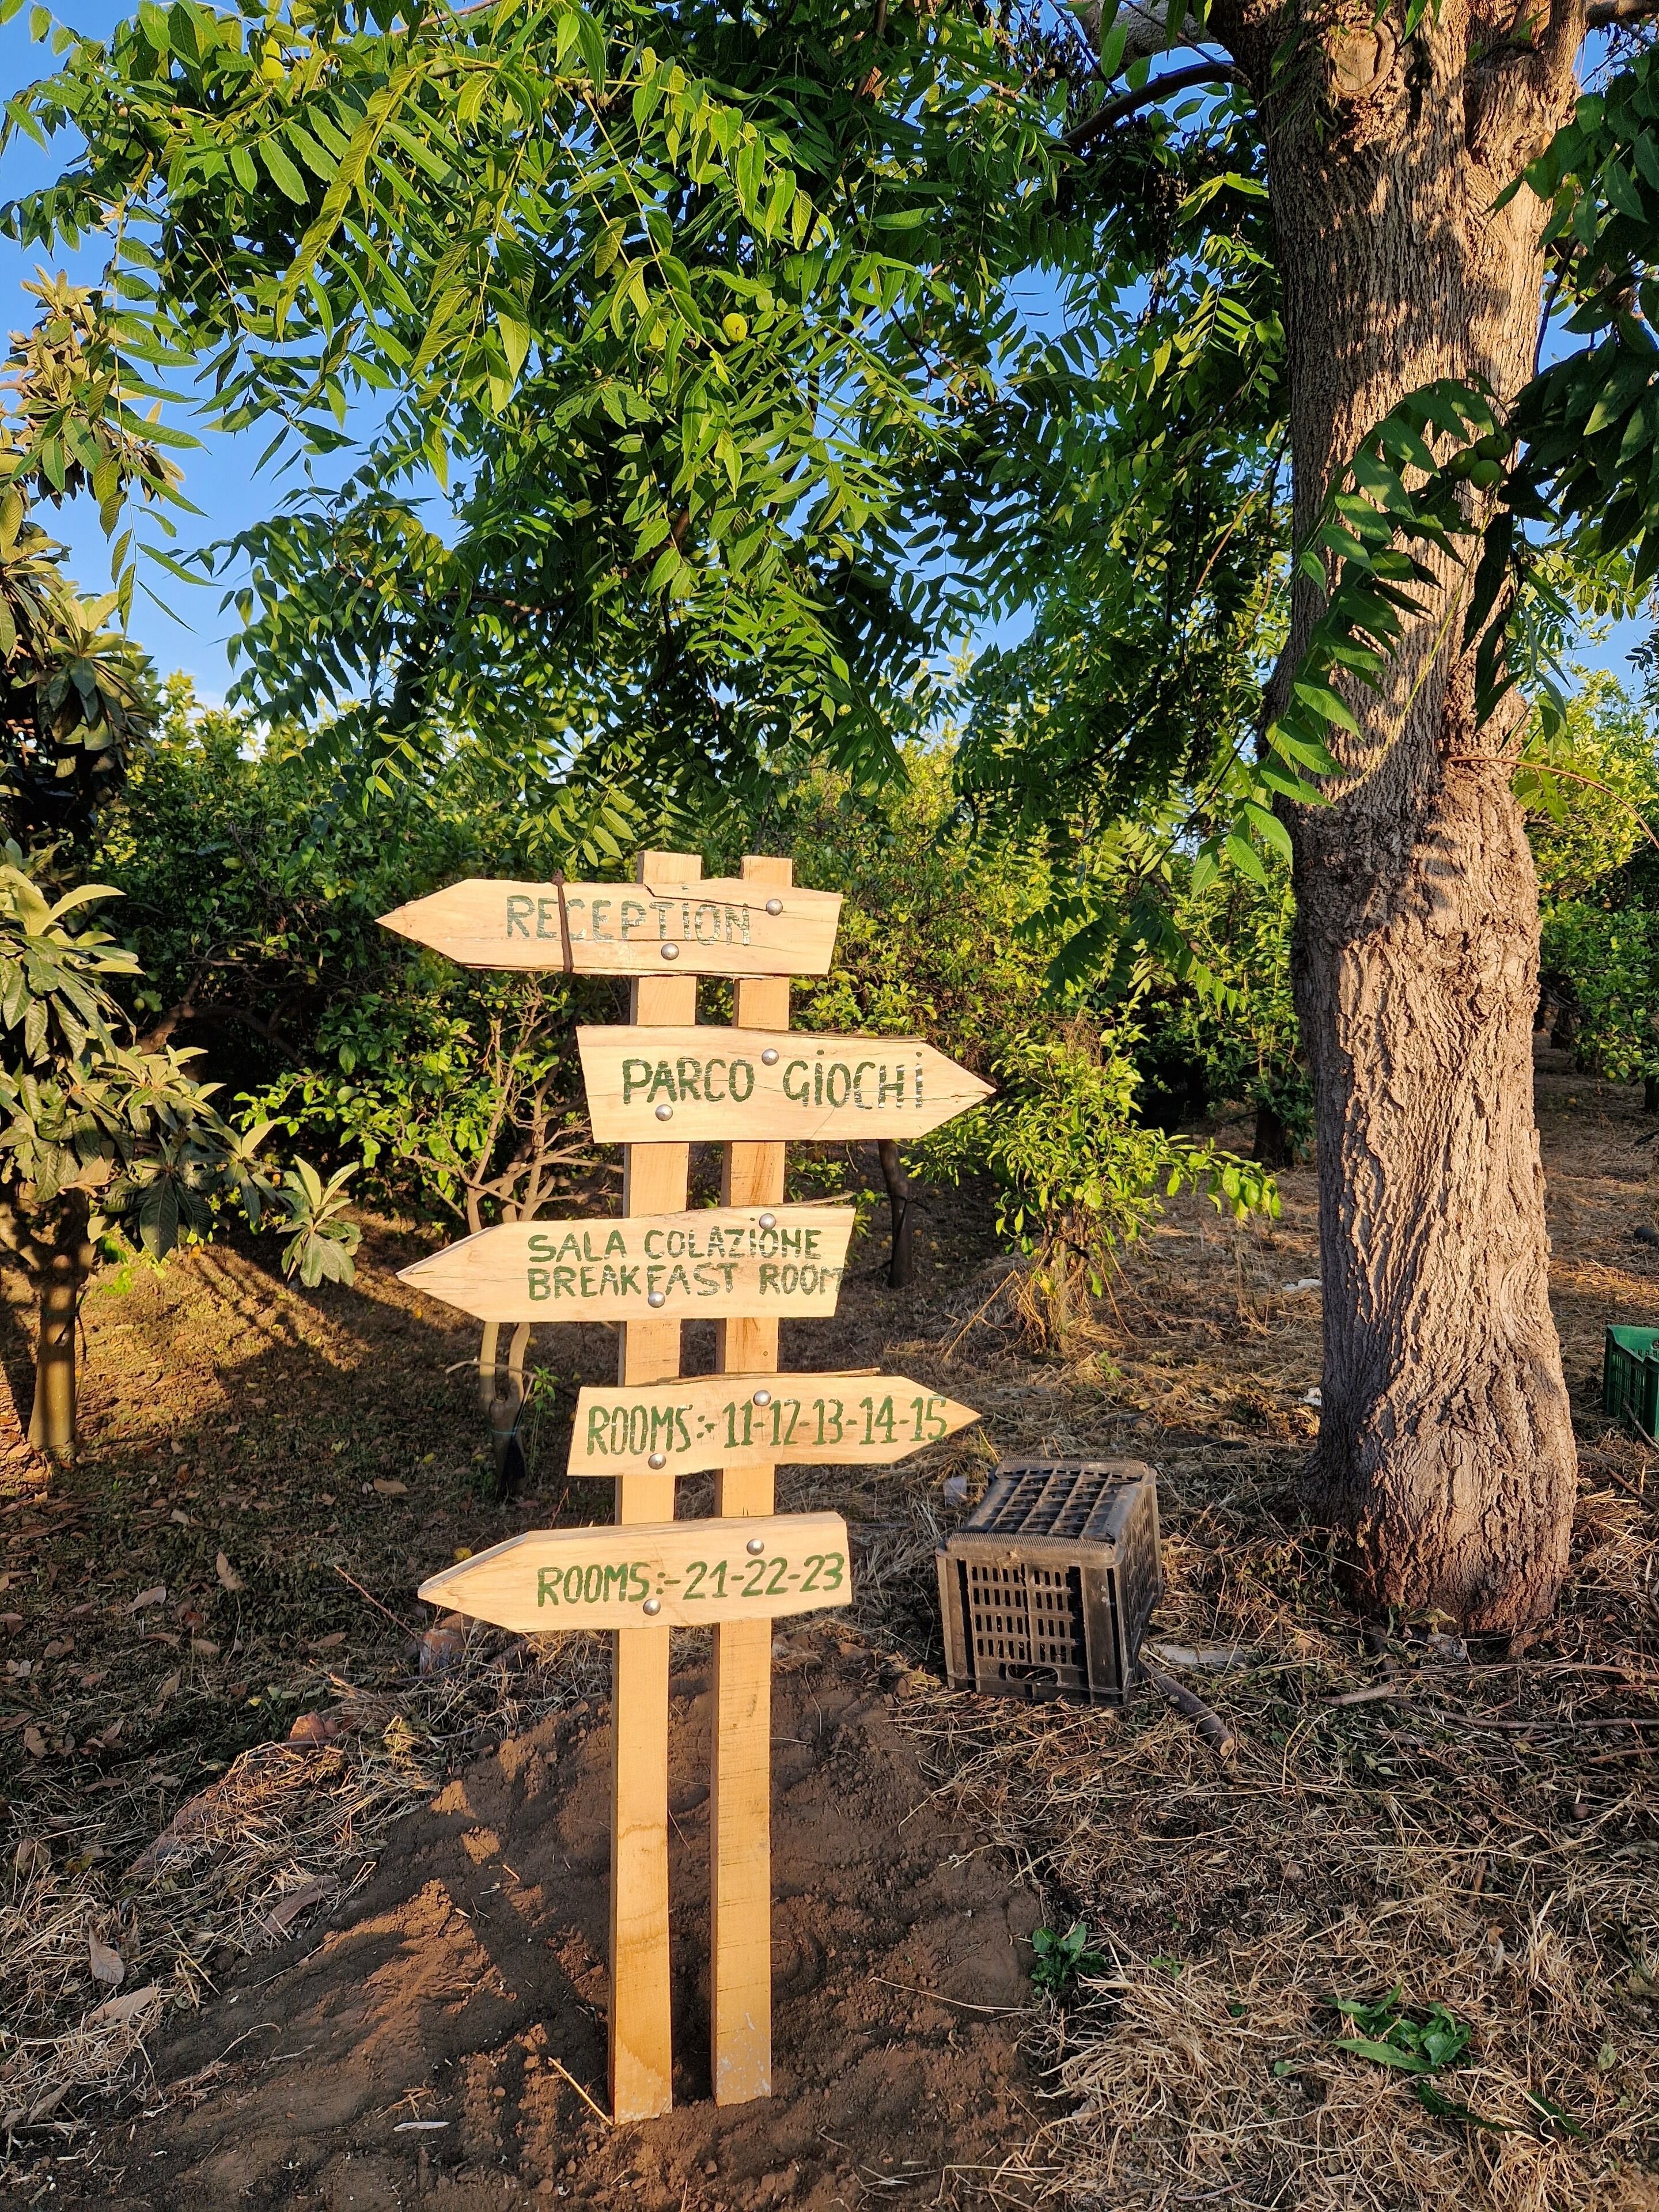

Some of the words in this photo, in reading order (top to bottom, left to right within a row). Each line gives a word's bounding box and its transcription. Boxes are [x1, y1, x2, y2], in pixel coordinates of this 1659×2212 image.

[507, 895, 751, 946] RECEPTION
[622, 1057, 755, 1104] PARCO
[528, 1229, 627, 1263] SALA
[644, 1217, 822, 1260] COLAZIONE
[527, 1262, 738, 1301] BREAKFAST
[759, 1263, 843, 1295] ROOM
